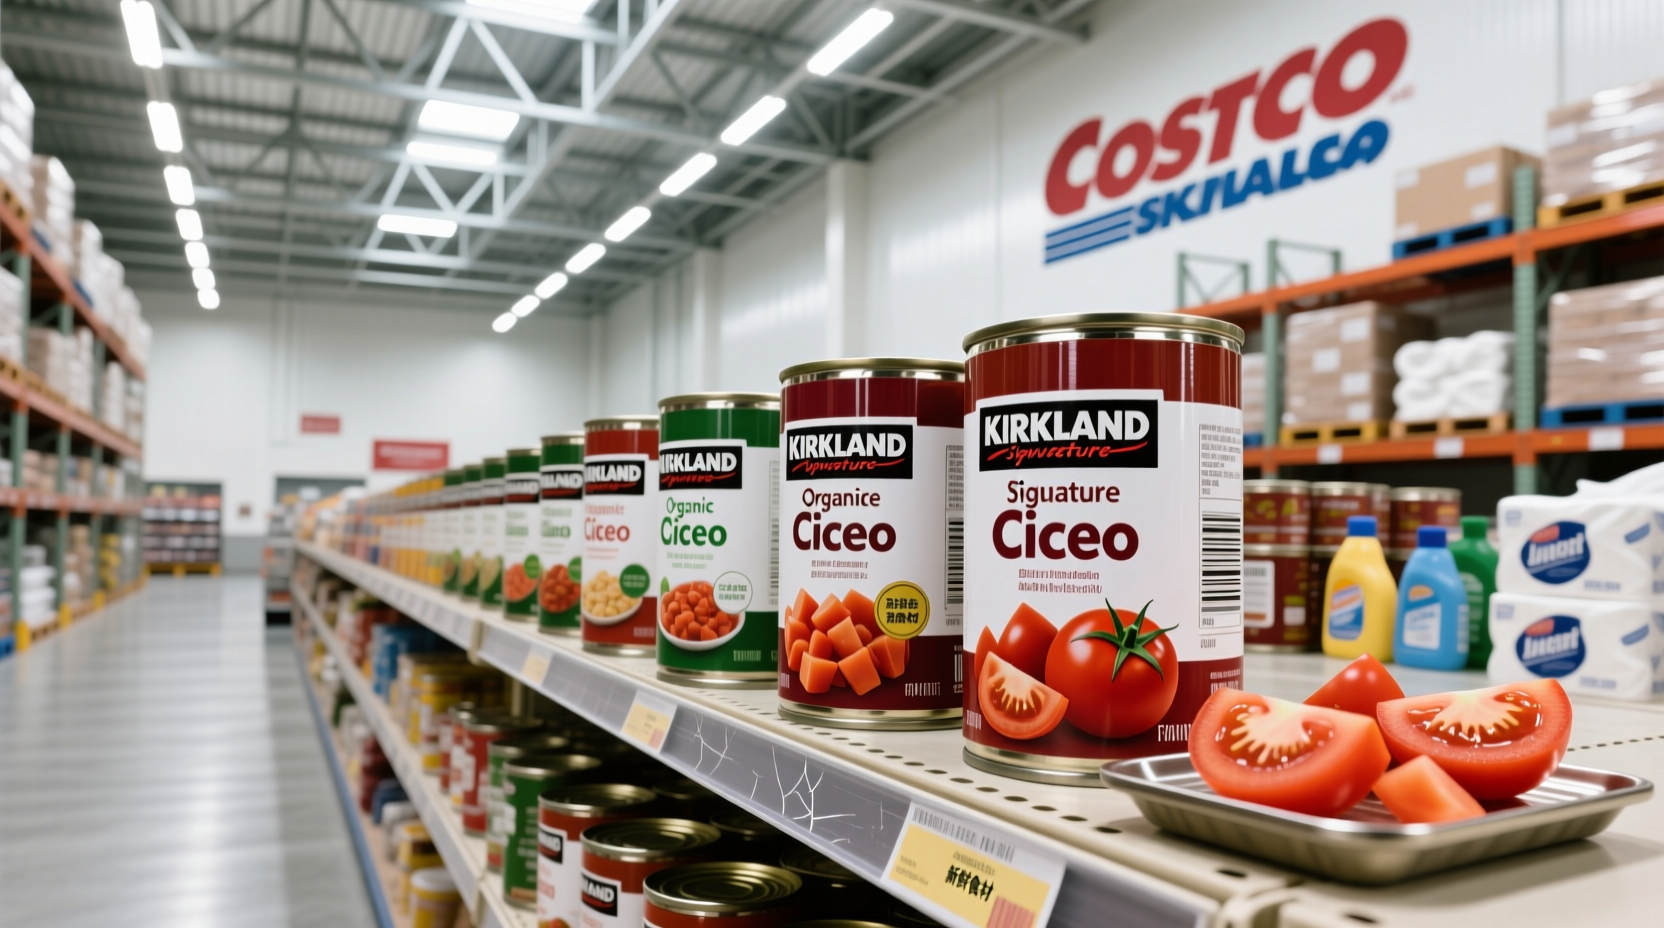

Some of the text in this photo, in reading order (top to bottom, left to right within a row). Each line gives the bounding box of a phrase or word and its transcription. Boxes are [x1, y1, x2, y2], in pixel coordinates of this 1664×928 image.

[1045, 17, 1409, 216] COSTCO
[984, 410, 1150, 447] KIRKLAND
[789, 433, 907, 461] KIRKLAND
[802, 487, 881, 512] Organice
[1007, 480, 1120, 509] Siguature
[661, 516, 727, 547] Ciceo
[793, 511, 896, 553] Ciceo
[992, 508, 1139, 561] Ciceo
